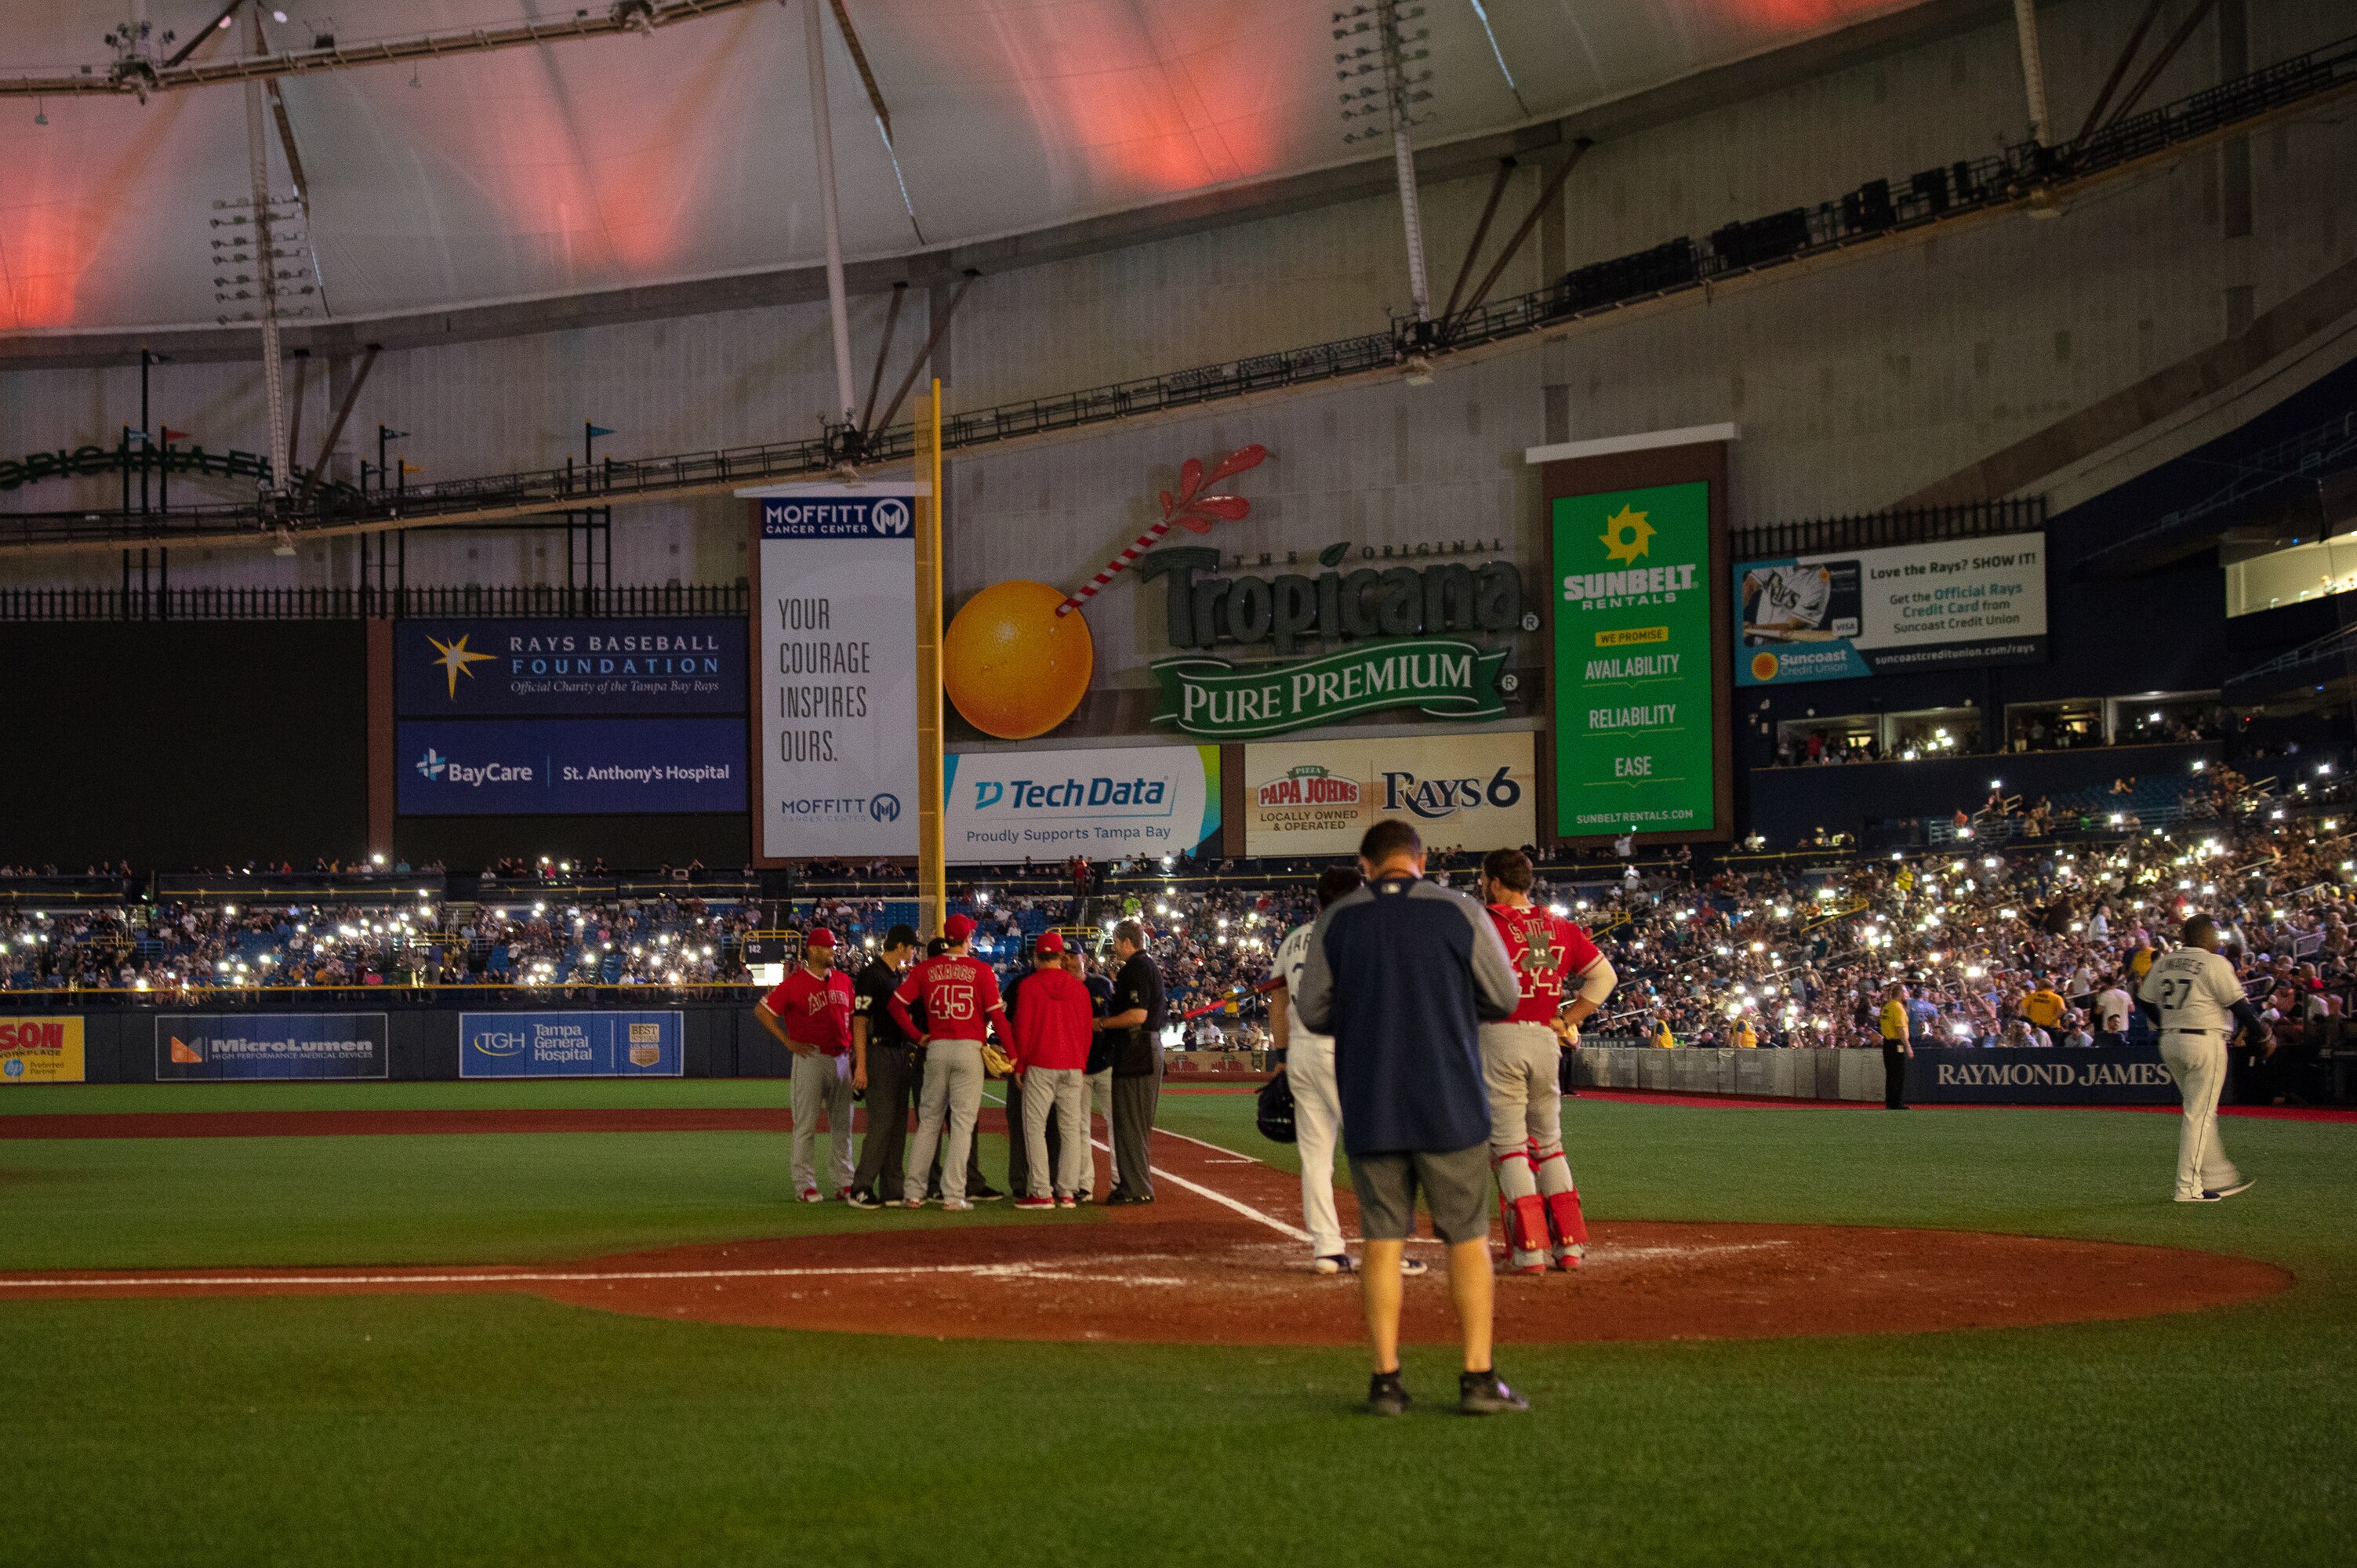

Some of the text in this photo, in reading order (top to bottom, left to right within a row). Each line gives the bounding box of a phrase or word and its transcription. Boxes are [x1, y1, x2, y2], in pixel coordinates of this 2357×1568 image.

[766, 505, 867, 524] MOFFITT
[766, 524, 868, 534] CANCER CENTER
[1362, 539, 1505, 560] ORIGINAL
[1870, 567, 1901, 579] Love
[1905, 564, 1926, 575] the
[1930, 559, 1968, 574] Rays?
[1973, 554, 2014, 569] SHOW
[2018, 553, 2036, 564] IT!
[1563, 564, 1696, 601] SUNBELT
[1142, 545, 1521, 655] Tropicana
[1582, 593, 1676, 610] RENTALS
[1890, 583, 2023, 604] Get the Official Rays
[779, 598, 830, 630] YOUR
[1902, 600, 2010, 618] Credit Card from
[1894, 613, 2020, 633] Suncoast Credit Union
[510, 636, 719, 651] RAYS BASEBALL
[1600, 630, 1663, 643] WE PROMISE
[512, 659, 718, 675] FOUNDATION
[780, 642, 870, 673] COURAGE
[1780, 650, 1847, 666] Suncoast
[1585, 654, 1680, 681] AVAILABILITY
[1780, 663, 1847, 675] Credit Union
[510, 680, 719, 695] Official Charity of the Tampa Bay Rays
[1182, 654, 1473, 724] PURE PREMIUM
[780, 686, 866, 718] INSPIRES
[1589, 704, 1676, 729] RELIABILITY
[781, 731, 837, 762] OURS.
[449, 763, 532, 786] BayCare
[563, 764, 729, 783] St. Anthony's Hospital
[1615, 756, 1652, 777] EASE
[1261, 778, 1358, 804] PAPA JOHNS
[1487, 766, 1521, 808] 6
[782, 799, 866, 814] MOFFITT
[1261, 811, 1359, 821] LOCALLY OWNED
[967, 826, 1171, 844] Proudly Supports Tampa Bay
[1285, 821, 1346, 830] OPERATED
[748, 945, 761, 953] 142
[928, 964, 977, 982] SKAGGS
[928, 985, 975, 1020] 45
[2160, 978, 2193, 1010] 27
[533, 1024, 582, 1037] Tampa
[631, 1025, 658, 1035] BEST
[212, 1039, 372, 1052] MicroLumen
[481, 1032, 525, 1048] TGH
[534, 1036, 589, 1048] General
[534, 1047, 593, 1063] Hospital
[1938, 1063, 2172, 1086] RAYMOND JAMES
